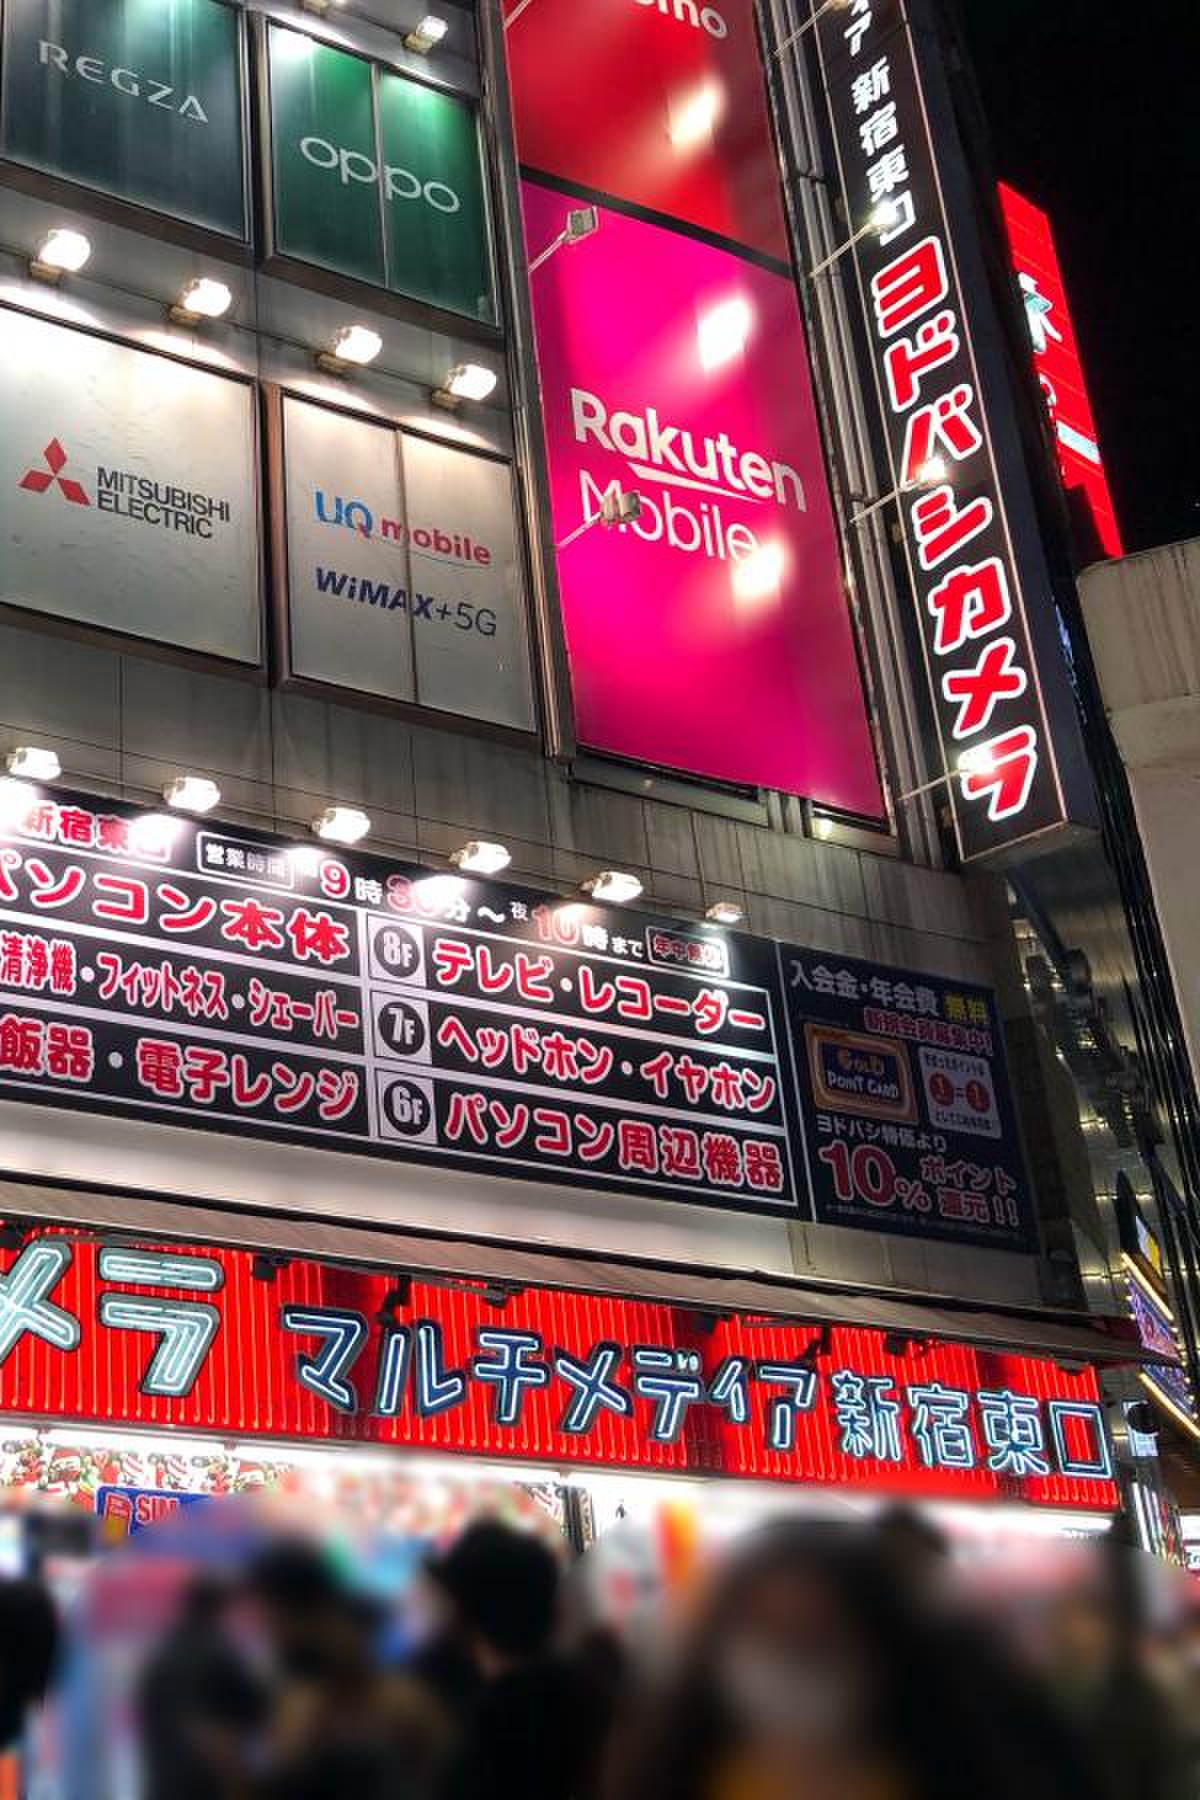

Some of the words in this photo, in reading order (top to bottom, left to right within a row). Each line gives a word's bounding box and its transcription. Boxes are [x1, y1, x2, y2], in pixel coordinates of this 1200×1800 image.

[38, 40, 209, 123] REGZA
[299, 136, 461, 214] oppo
[570, 388, 808, 512] Rakuten
[97, 465, 230, 523] MITSUBISHI
[97, 490, 212, 539] ELECTRIC
[315, 490, 373, 540] UQ
[380, 515, 492, 566] mobile
[579, 470, 758, 562] Mobile
[870, 236, 1038, 822] ヨドバシカメラ
[382, 930, 413, 968] 8F
[386, 1010, 415, 1047] 7F
[392, 1083, 423, 1123] 6F
[445, 1090, 782, 1192] パソコン周辺機器
